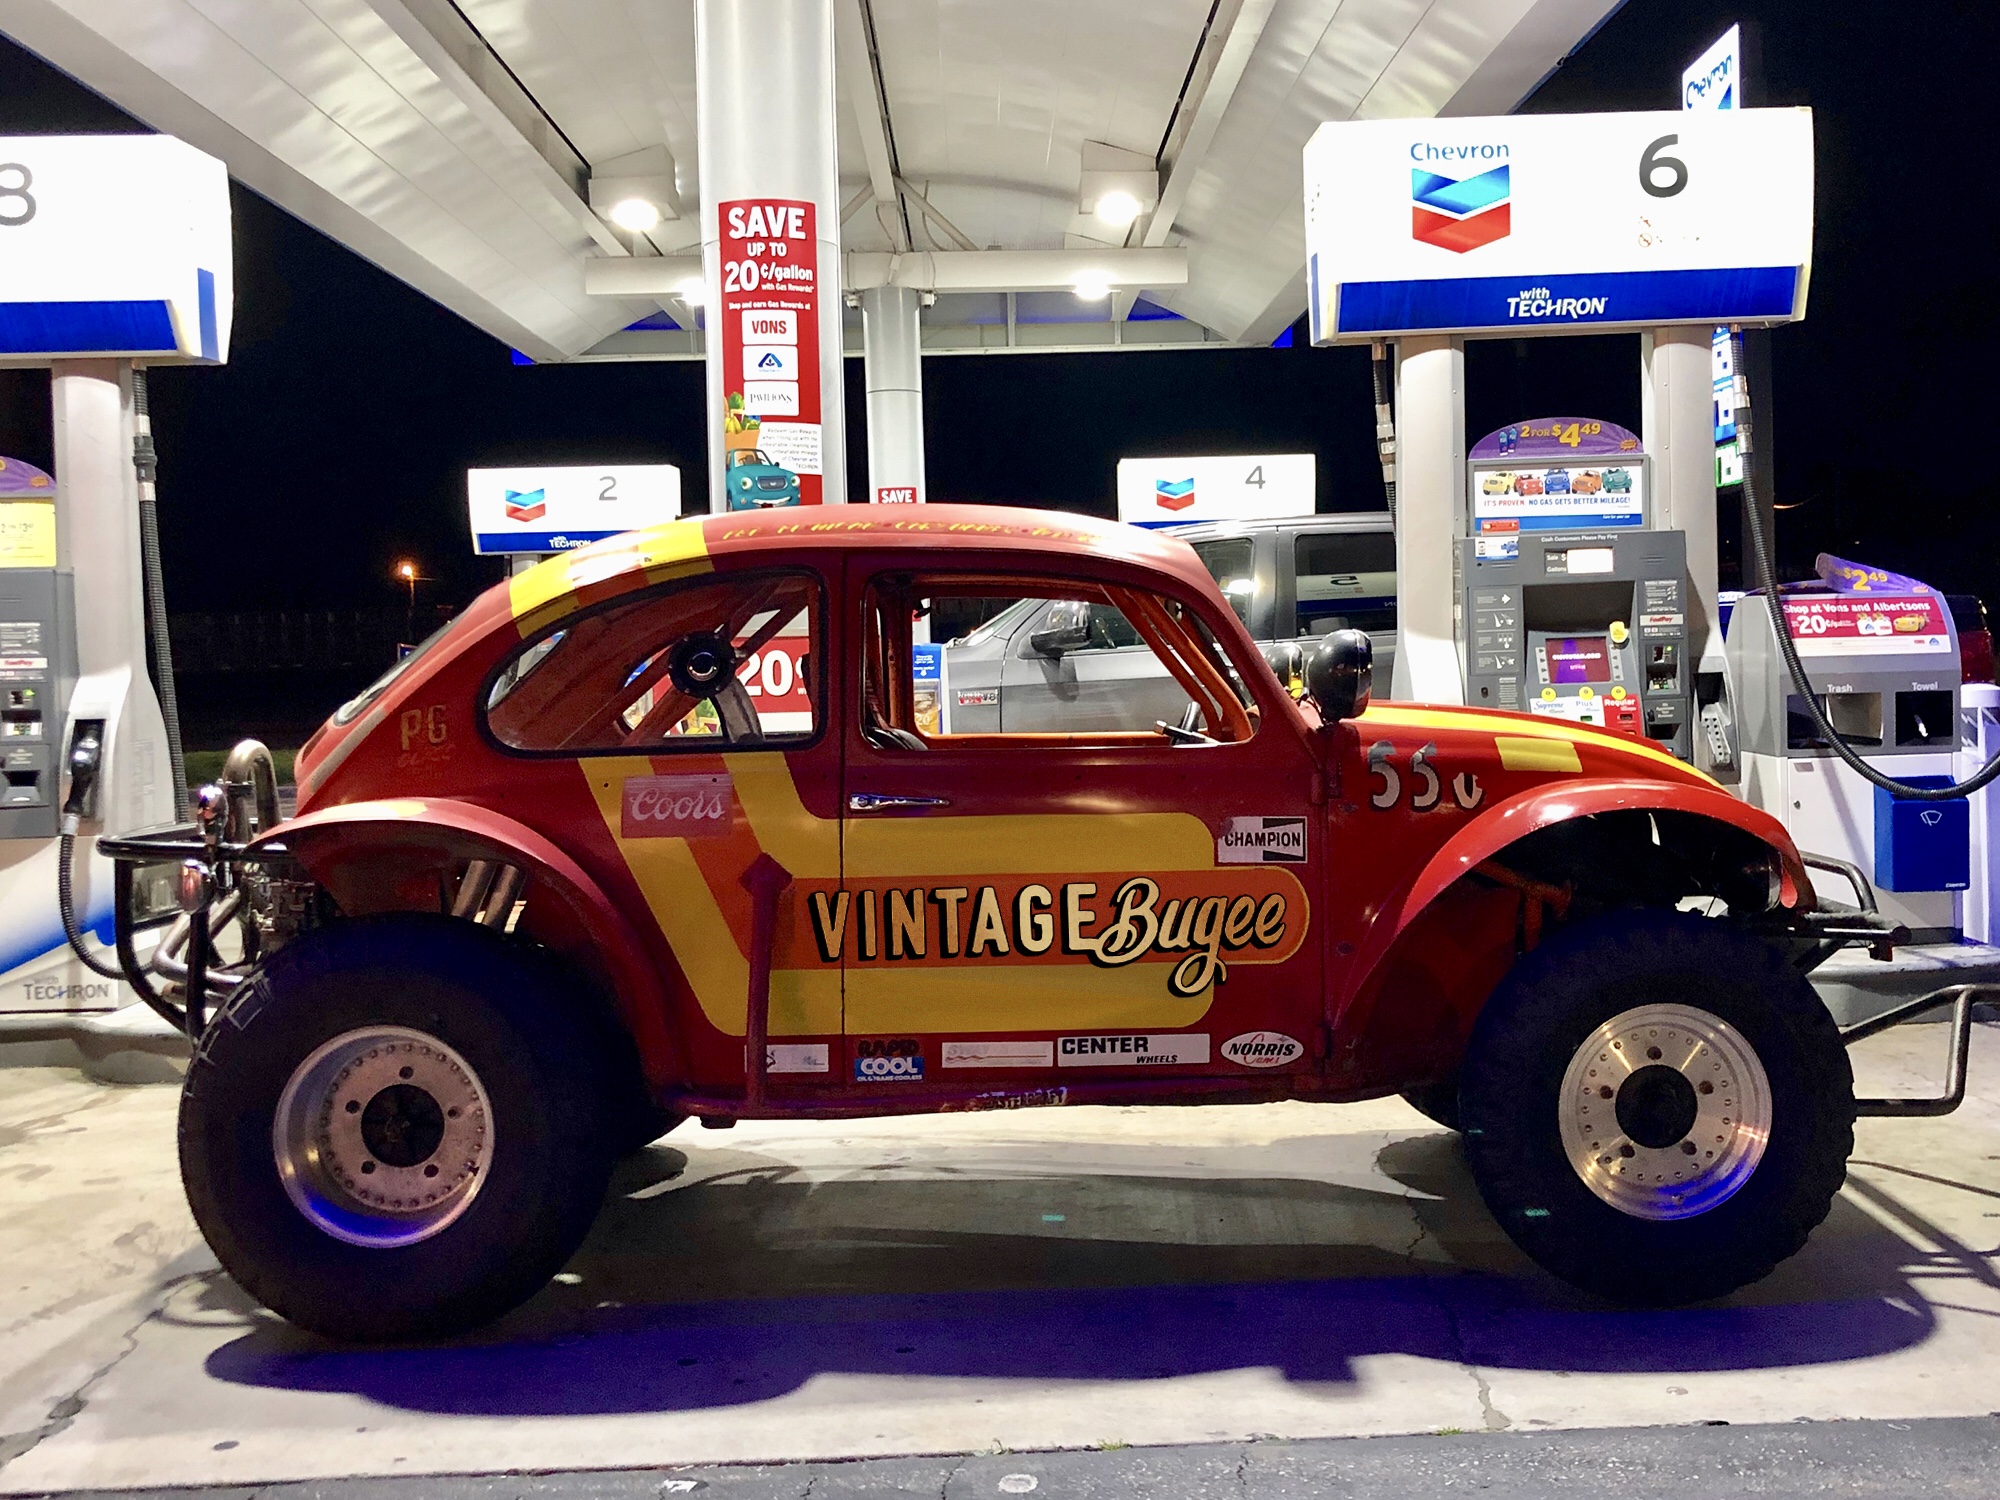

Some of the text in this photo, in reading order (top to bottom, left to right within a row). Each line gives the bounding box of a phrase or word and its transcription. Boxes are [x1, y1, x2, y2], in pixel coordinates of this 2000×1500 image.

[1686, 55, 1731, 109] Chevron
[1410, 142, 1509, 161] Chevron
[1639, 134, 1688, 198] 6
[0, 163, 36, 226] 8
[728, 205, 806, 240] SAVE
[747, 242, 787, 257] UP TO
[1519, 287, 1550, 299] with
[1507, 297, 1606, 318] TECHRON
[752, 320, 787, 334] VONS
[750, 393, 792, 404] PAVILIONS
[1520, 426, 1530, 437] 2
[1531, 428, 1551, 437] FOR
[1245, 466, 1266, 489] 4
[598, 475, 617, 501] 2
[881, 489, 913, 503] SAVE
[1573, 497, 1598, 505] BETTER
[1561, 553, 1566, 561] $
[1783, 602, 1931, 614] Shop at Vons and Albertsons
[1827, 684, 1853, 693] Trash
[1911, 682, 1938, 691] Towel
[1534, 701, 1564, 711] Supreme
[1604, 699, 1636, 707] Regular
[401, 704, 447, 750] PG
[629, 787, 726, 820] Coors
[1224, 831, 1301, 847] CHAMPION
[808, 877, 1287, 997] VINTAGE Bugee
[23, 983, 109, 1001] TECHRON
[1062, 1036, 1149, 1055] CENTER
[1228, 1043, 1296, 1056] NORRIS
[860, 1057, 919, 1075] COOL
[1136, 1055, 1178, 1064] WHEELS
